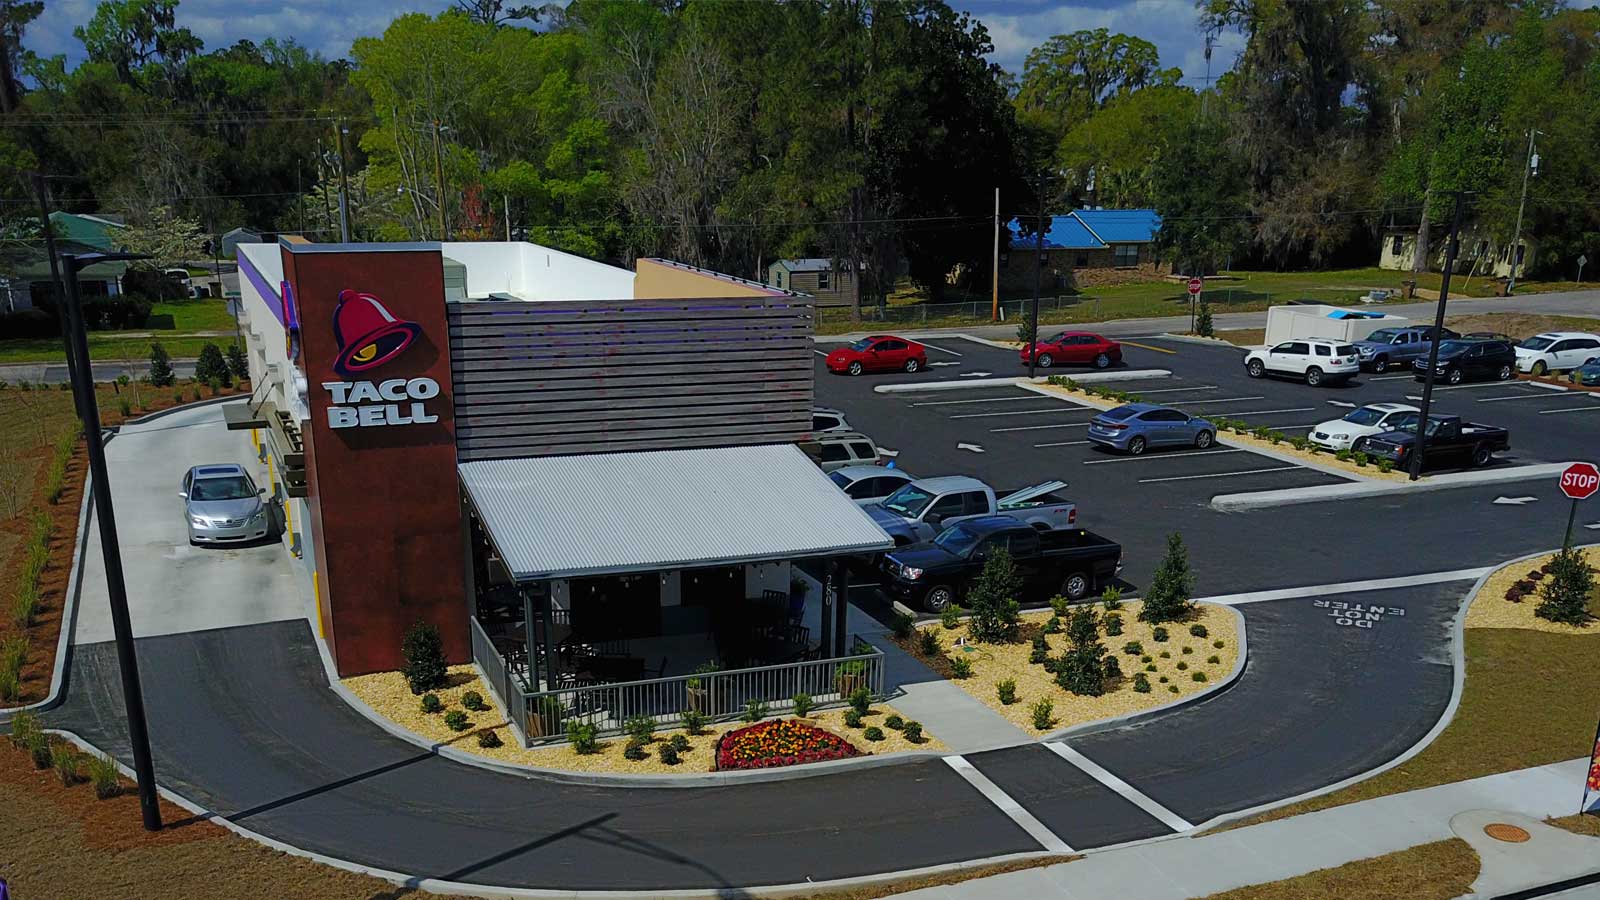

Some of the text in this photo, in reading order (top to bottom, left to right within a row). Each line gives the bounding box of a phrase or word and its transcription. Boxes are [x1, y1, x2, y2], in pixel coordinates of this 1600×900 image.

[321, 377, 440, 404] TACO
[327, 402, 438, 429] BELL
[1563, 472, 1597, 488] STOP
[1313, 600, 1405, 616] ENTER
[1328, 609, 1380, 621] NOT
[1335, 618, 1373, 628] DO
